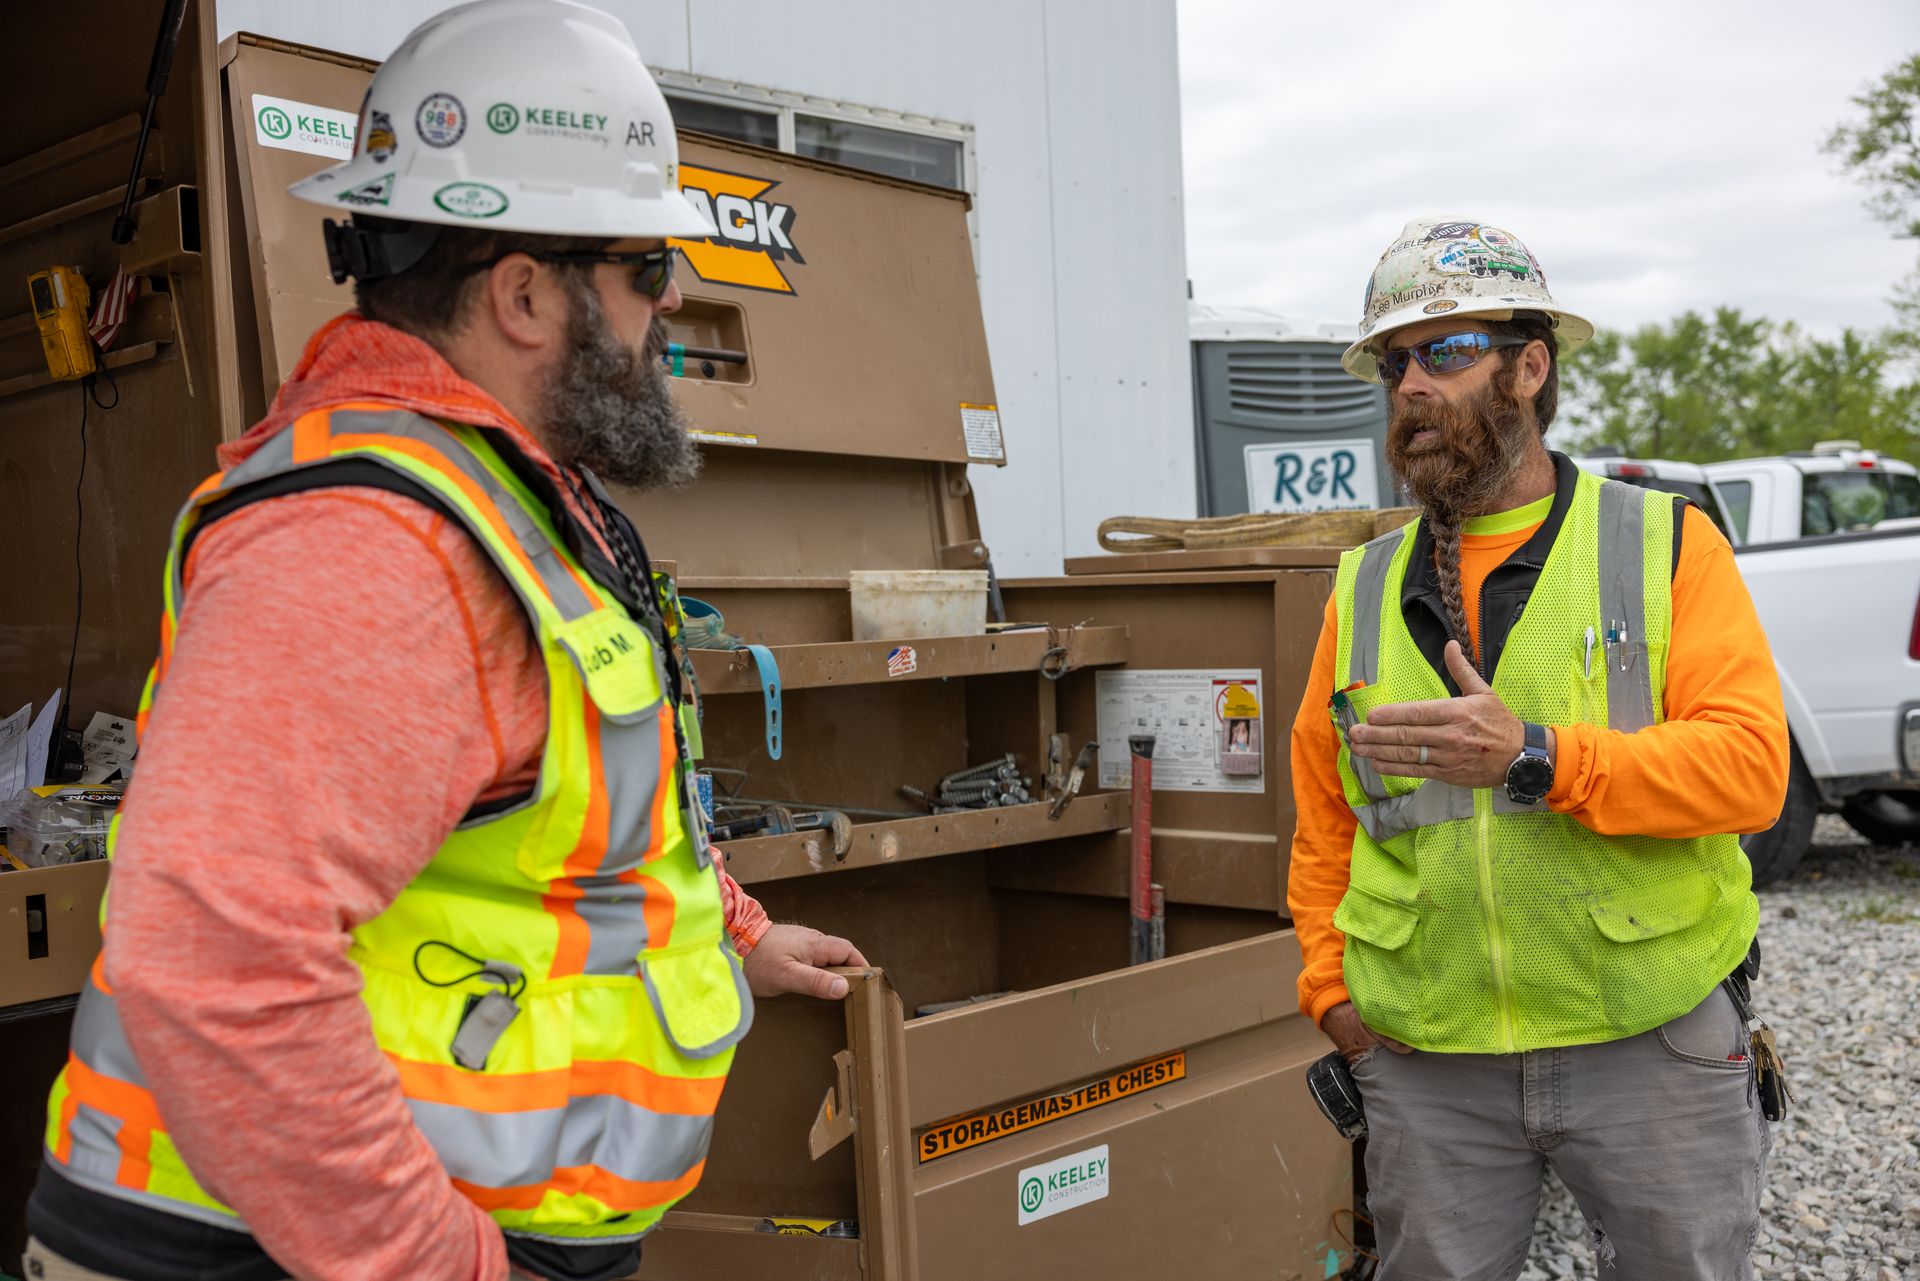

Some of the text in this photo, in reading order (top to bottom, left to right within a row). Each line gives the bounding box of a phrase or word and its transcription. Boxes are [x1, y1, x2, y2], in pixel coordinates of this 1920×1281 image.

[297, 115, 358, 141] KEEL
[426, 109, 457, 128] 988
[526, 107, 608, 131] KEELEY
[300, 132, 354, 150] CONSTRUC
[526, 126, 609, 145] CONSTRUCTION
[625, 121, 656, 147] AR
[683, 186, 797, 250] ACK
[1430, 223, 1475, 240] Gemma
[1390, 238, 1425, 255] KEELE
[1274, 449, 1357, 504] R&R
[924, 1078, 1111, 1155] STORAGEMASTER
[1048, 1157, 1108, 1192] KEELEY
[1048, 1177, 1107, 1203] CONSTRUCTION
